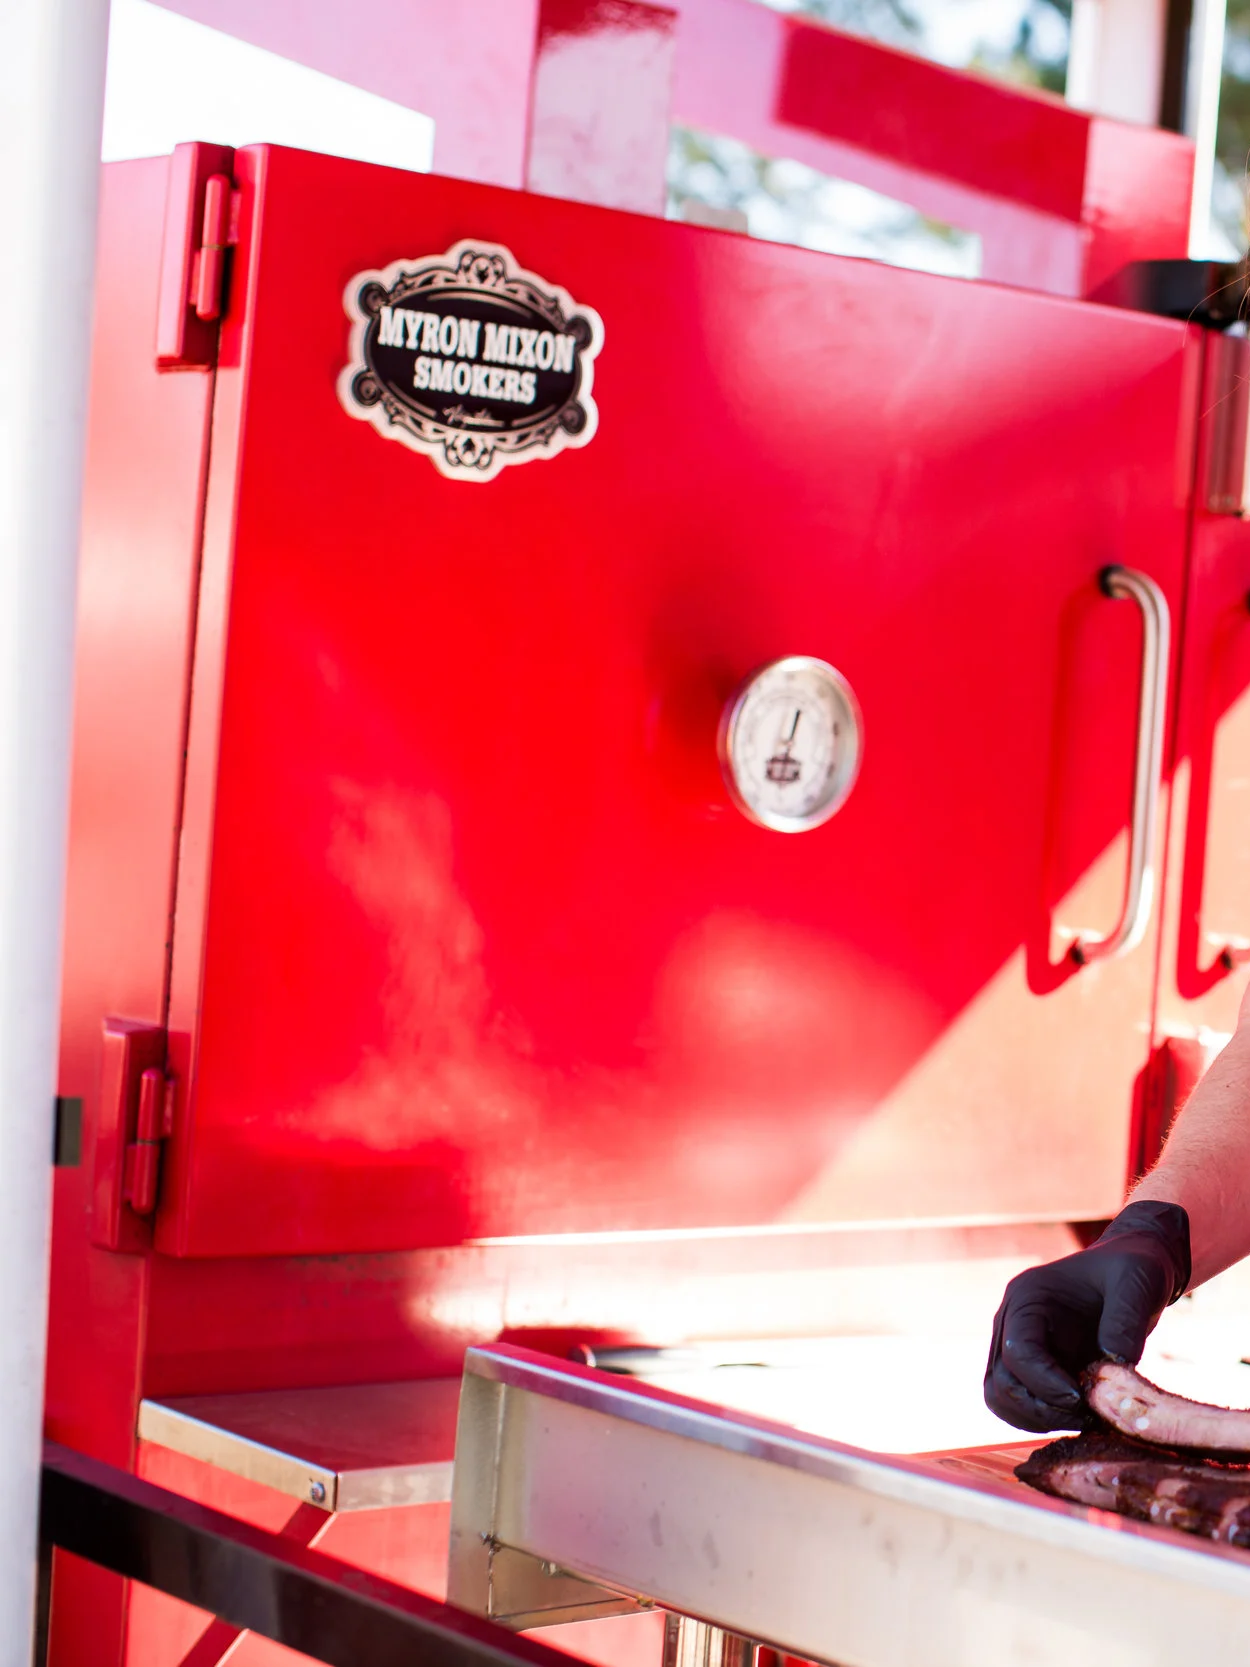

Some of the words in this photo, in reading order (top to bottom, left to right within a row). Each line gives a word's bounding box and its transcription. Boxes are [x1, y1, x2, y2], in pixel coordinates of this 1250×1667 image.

[378, 307, 480, 359] MYRON
[483, 323, 576, 373] MIXON
[413, 356, 537, 404] SMOKERS
